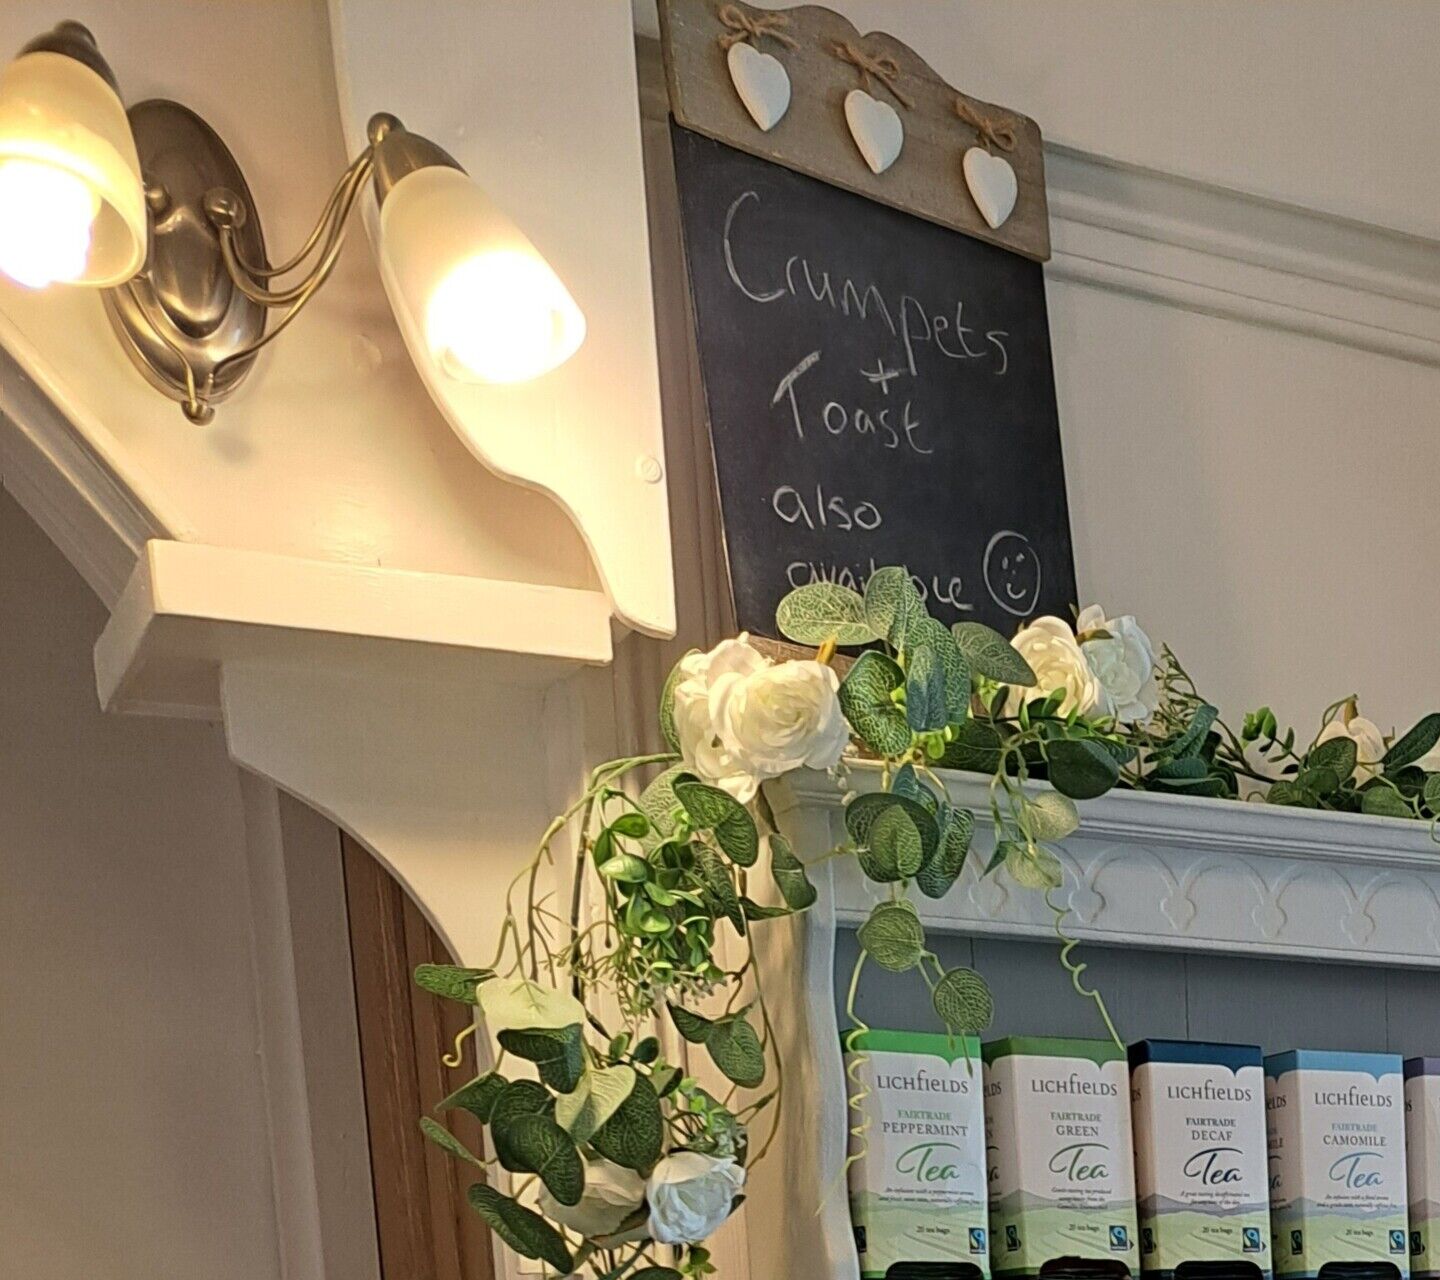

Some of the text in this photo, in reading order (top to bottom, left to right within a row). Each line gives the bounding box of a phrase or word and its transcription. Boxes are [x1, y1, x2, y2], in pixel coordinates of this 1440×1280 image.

[723, 190, 1009, 376] Crumpets
[772, 350, 933, 453] Toast
[772, 483, 882, 532] also
[882, 1121, 969, 1138] PEPPERMINT
[1050, 1111, 1103, 1123] FAIRTRADE
[1055, 1125, 1100, 1138] GREEN
[1185, 1116, 1237, 1128] FAIRTRADE
[1191, 1130, 1233, 1143] DECAF
[1322, 1134, 1387, 1148] CAMOMILE
[896, 1141, 961, 1183] Tea
[1048, 1142, 1110, 1182] Tea
[1183, 1147, 1244, 1186] Tea
[1328, 1151, 1385, 1189] Tea
